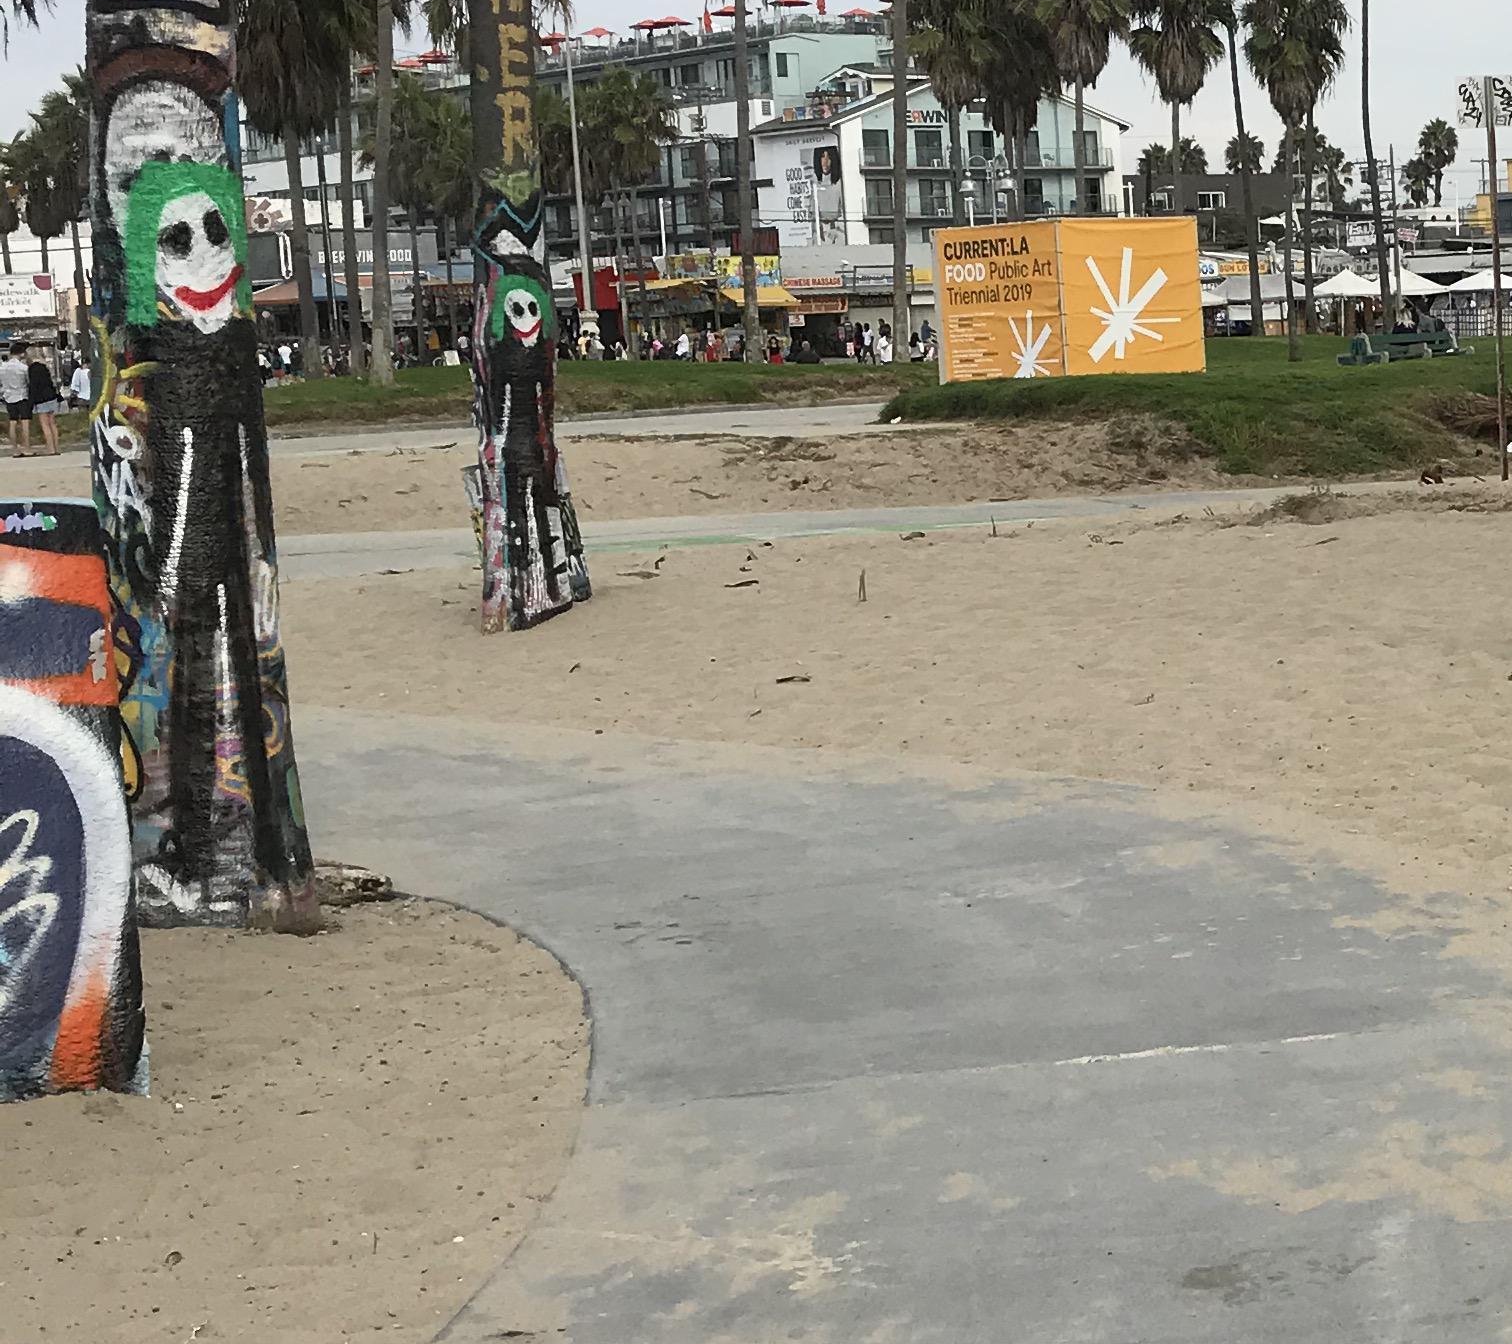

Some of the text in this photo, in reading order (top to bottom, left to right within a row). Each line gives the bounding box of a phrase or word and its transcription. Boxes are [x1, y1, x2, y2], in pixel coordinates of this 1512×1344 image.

[388, 249, 412, 261] OOD
[943, 236, 1030, 261] CURRENT:LA
[944, 258, 1052, 283] FOOD Public Art
[783, 277, 841, 288] CHINESE MASSAGE
[947, 283, 1033, 306] Triennial 2019
